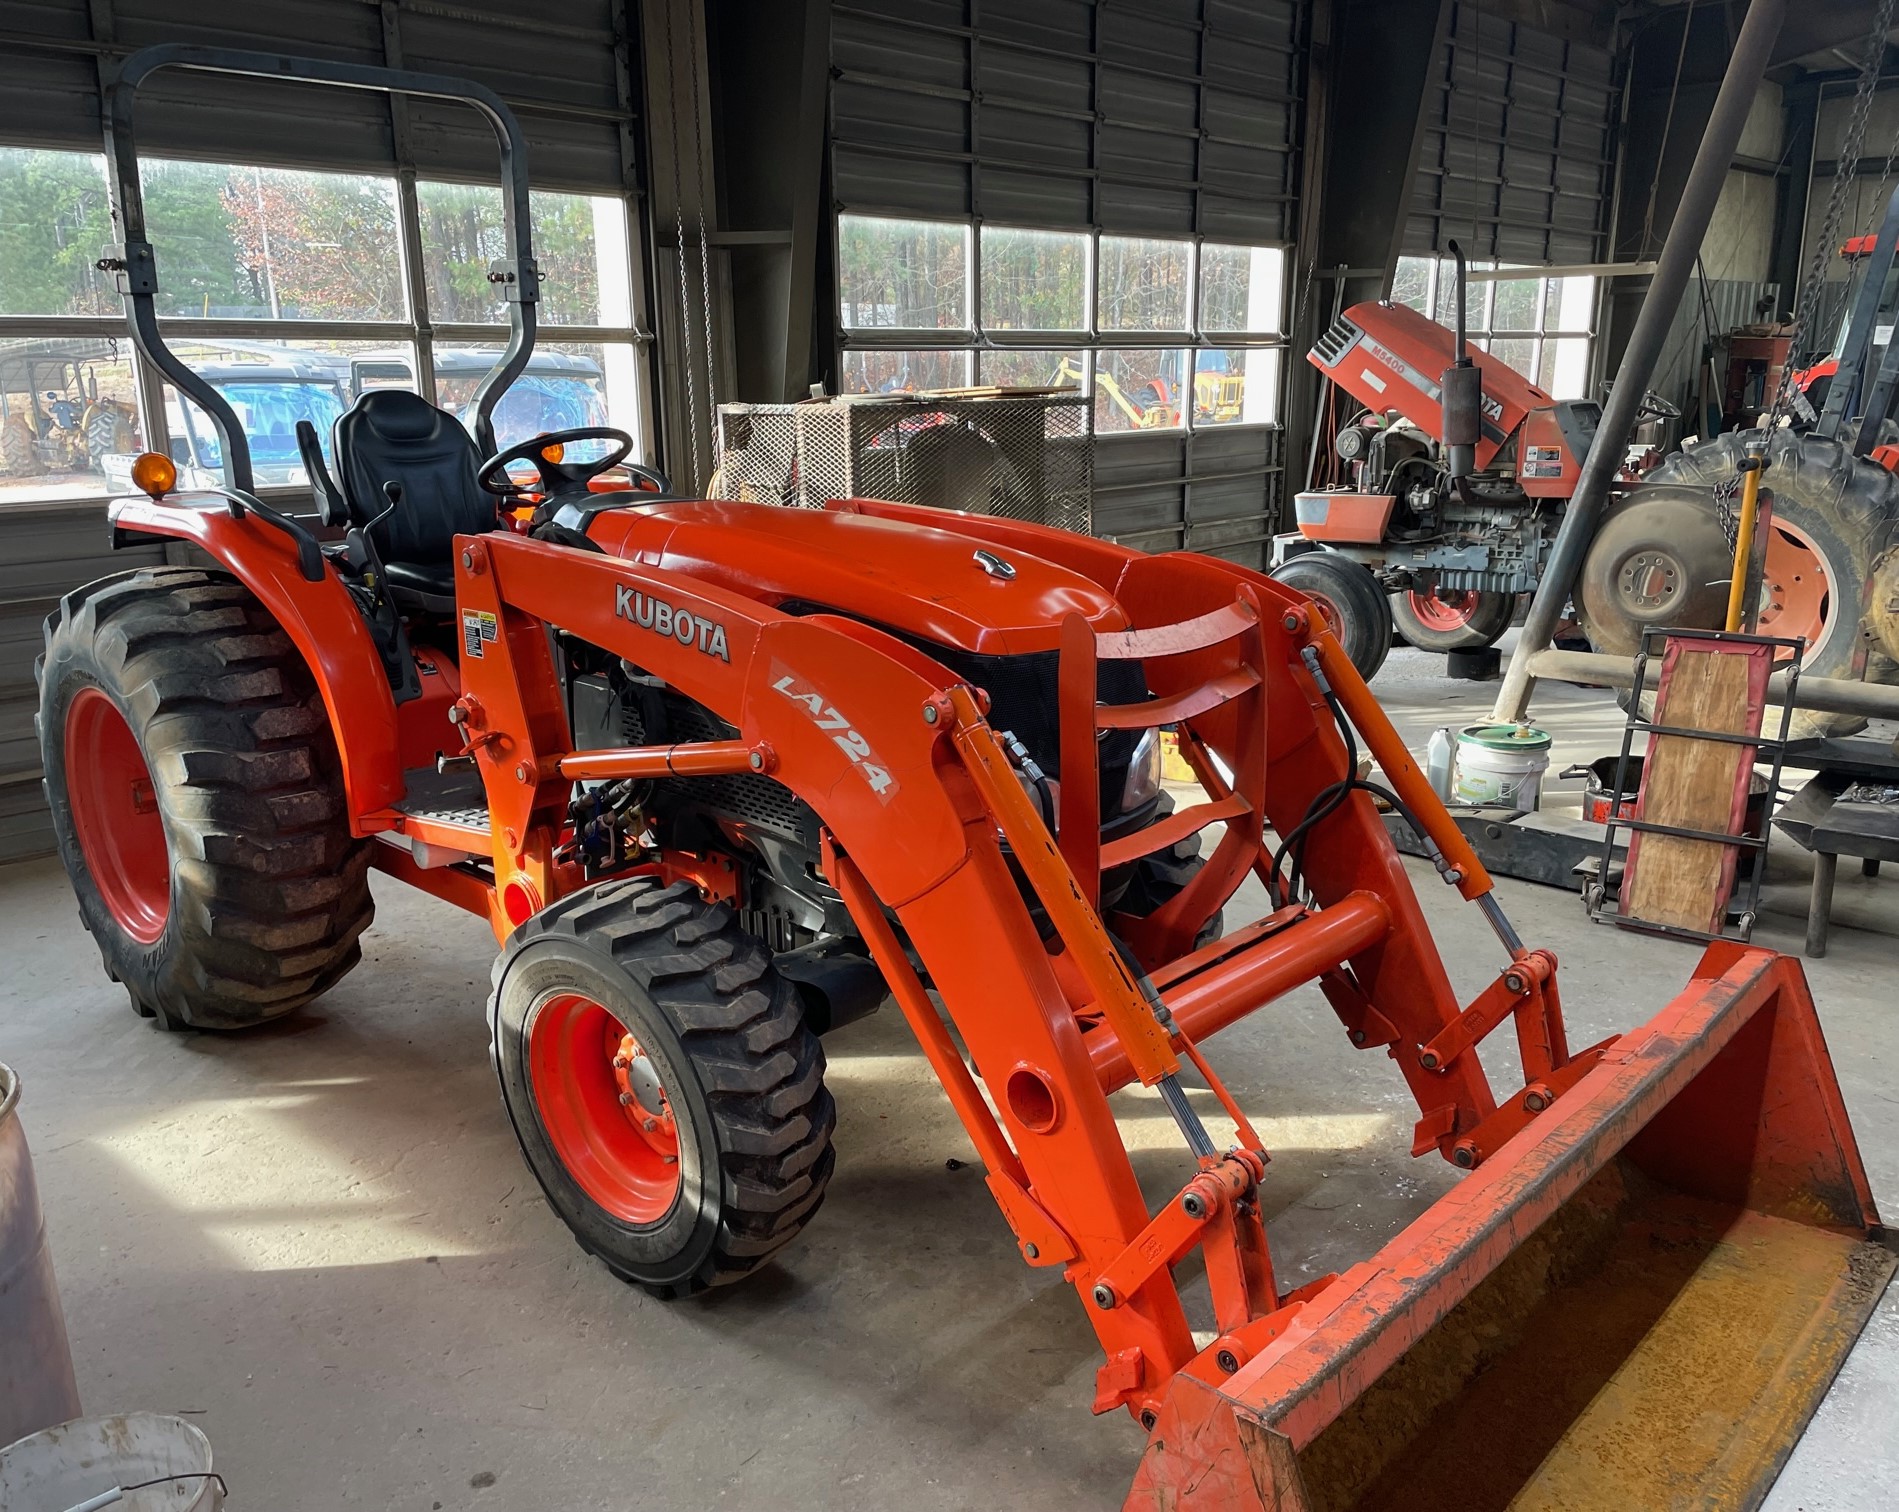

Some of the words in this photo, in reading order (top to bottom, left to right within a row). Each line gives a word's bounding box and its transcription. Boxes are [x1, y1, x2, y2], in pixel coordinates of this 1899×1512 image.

[1371, 345, 1405, 374] M5400
[615, 583, 731, 664] KUBOTA
[772, 675, 893, 795] LA724
